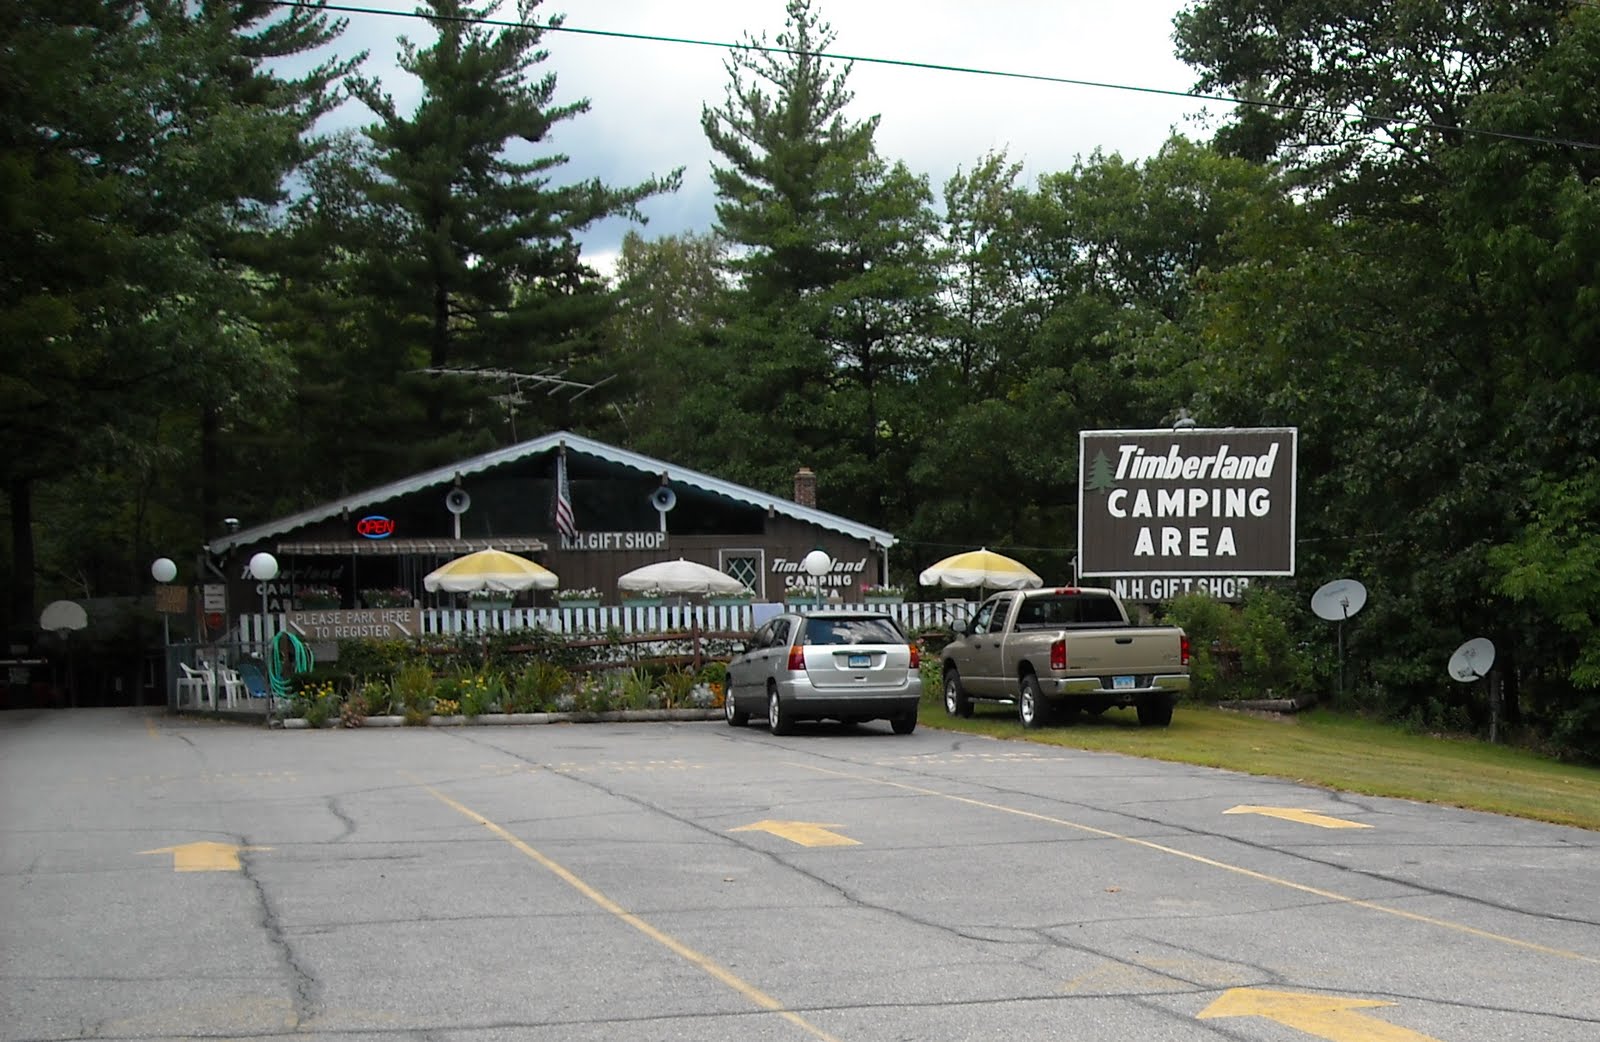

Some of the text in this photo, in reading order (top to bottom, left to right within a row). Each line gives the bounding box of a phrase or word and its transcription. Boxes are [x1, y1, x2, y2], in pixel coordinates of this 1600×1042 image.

[1115, 443, 1279, 480] Timberland
[1107, 488, 1271, 518] CAMPING
[357, 519, 394, 534] OPEN
[589, 533, 623, 549] GIFT
[625, 532, 665, 549] SHOP
[1133, 527, 1237, 557] AREA
[785, 575, 852, 586] CAMPING
[1115, 578, 1250, 599] N.H. GIFT SHOP
[295, 610, 411, 625] PLEASE PARK HERE
[315, 625, 390, 638] TO REGISTER
